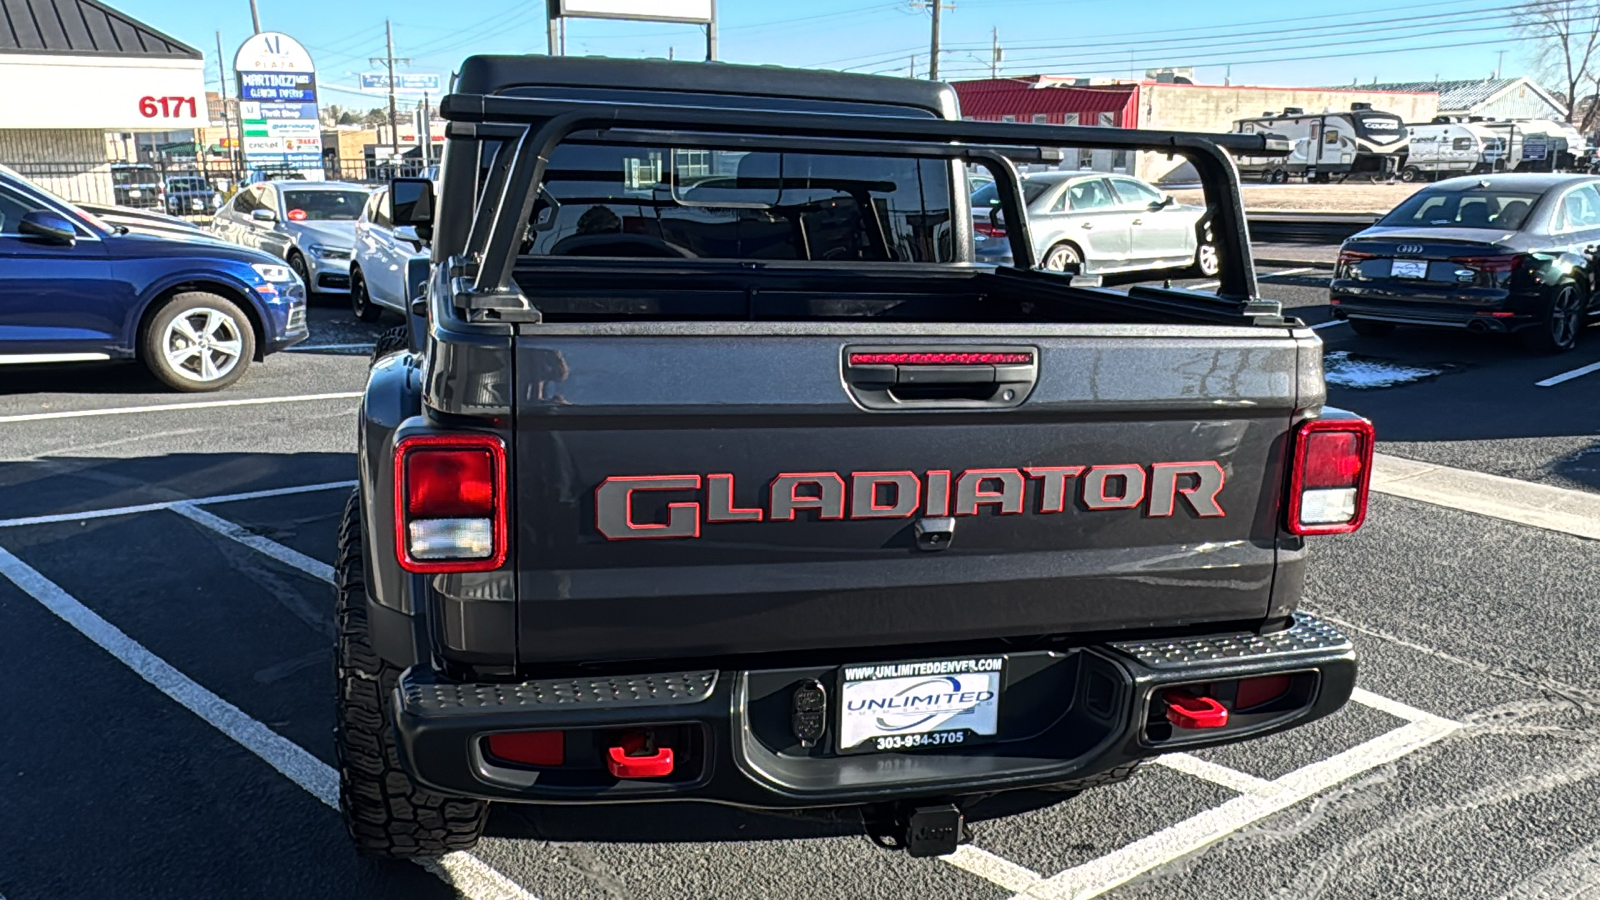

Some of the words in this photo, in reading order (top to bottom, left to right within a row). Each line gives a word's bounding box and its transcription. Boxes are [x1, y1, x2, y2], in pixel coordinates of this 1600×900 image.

[254, 61, 294, 69] PLAZA
[139, 96, 197, 118] 6171
[595, 460, 1226, 541] GLADIATOR
[845, 658, 1002, 681] WWW.UNLIMITEDDENVER.COM
[846, 691, 995, 712] UNLIMITED
[876, 731, 964, 750] 303-934-3705
